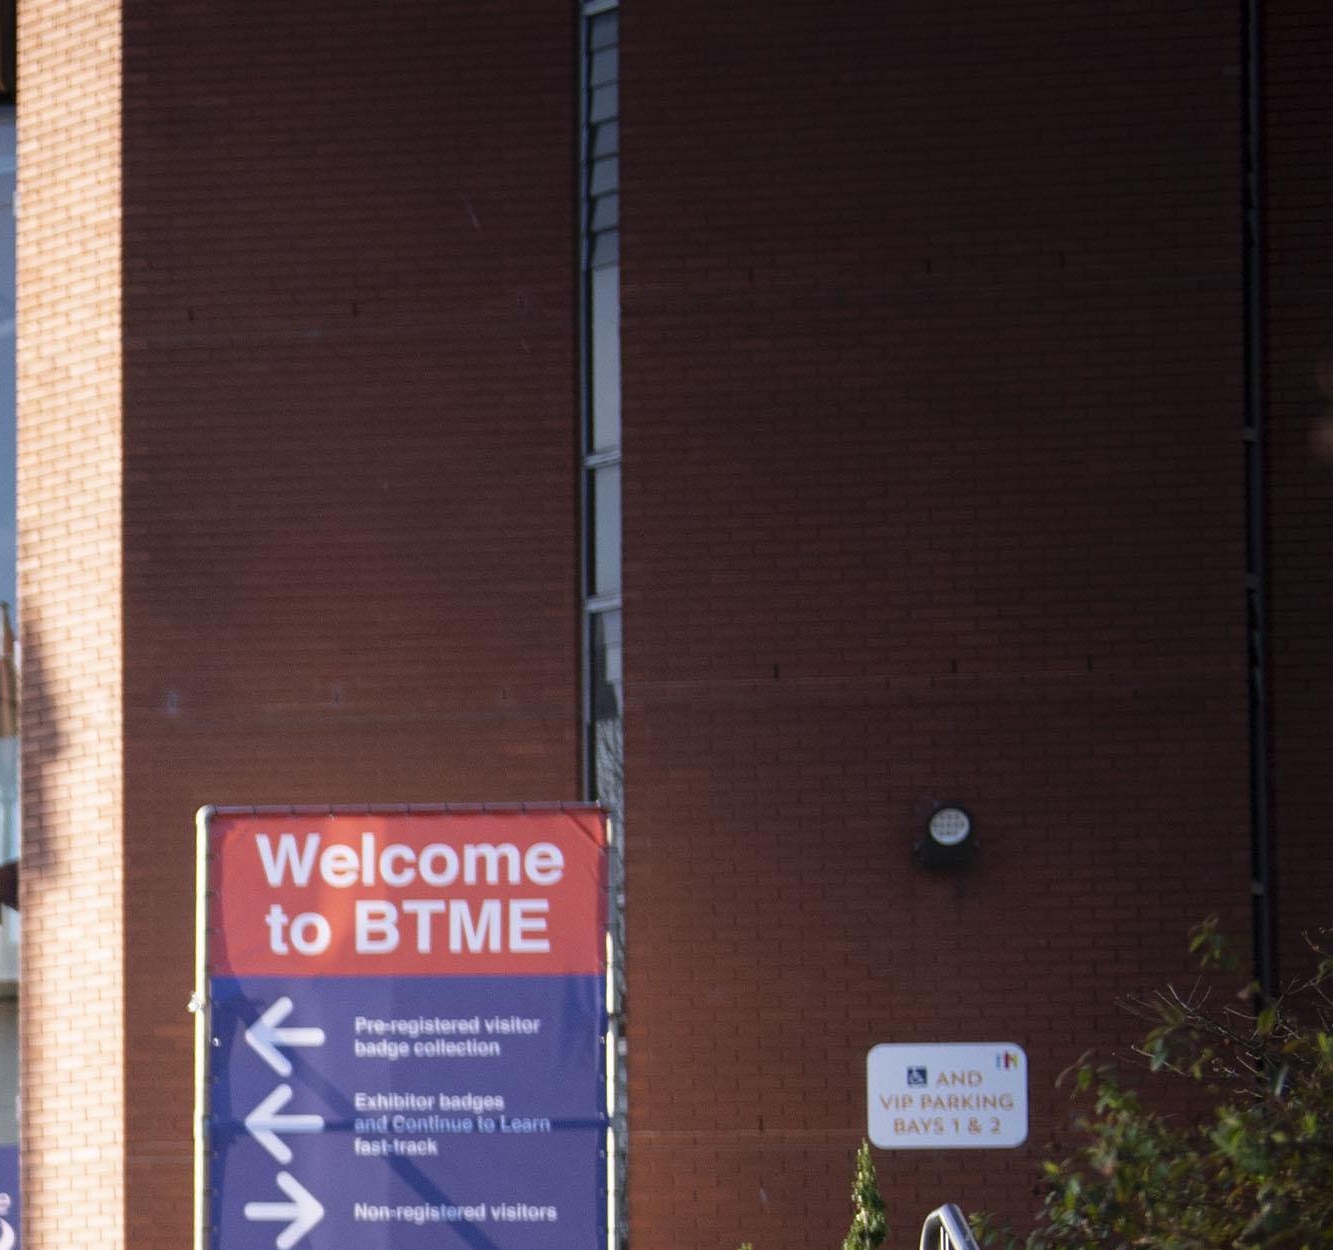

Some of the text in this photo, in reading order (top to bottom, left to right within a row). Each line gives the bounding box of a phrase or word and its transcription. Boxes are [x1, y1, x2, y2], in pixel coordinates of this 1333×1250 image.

[255, 832, 565, 887] Welcome
[265, 899, 551, 955] to BTME
[354, 1016, 541, 1038] Pre-registered visitor
[354, 1039, 501, 1061] badge collection
[936, 1070, 983, 1086] AND
[354, 1092, 505, 1114] Exhibitor badges
[880, 1093, 1015, 1110] VIP PARKING
[354, 1115, 551, 1133] and Continue to Learn
[894, 1117, 1001, 1135] BAYS 1 & 2
[354, 1137, 438, 1156] fast-track
[354, 1202, 558, 1224] Non-registered visitors
